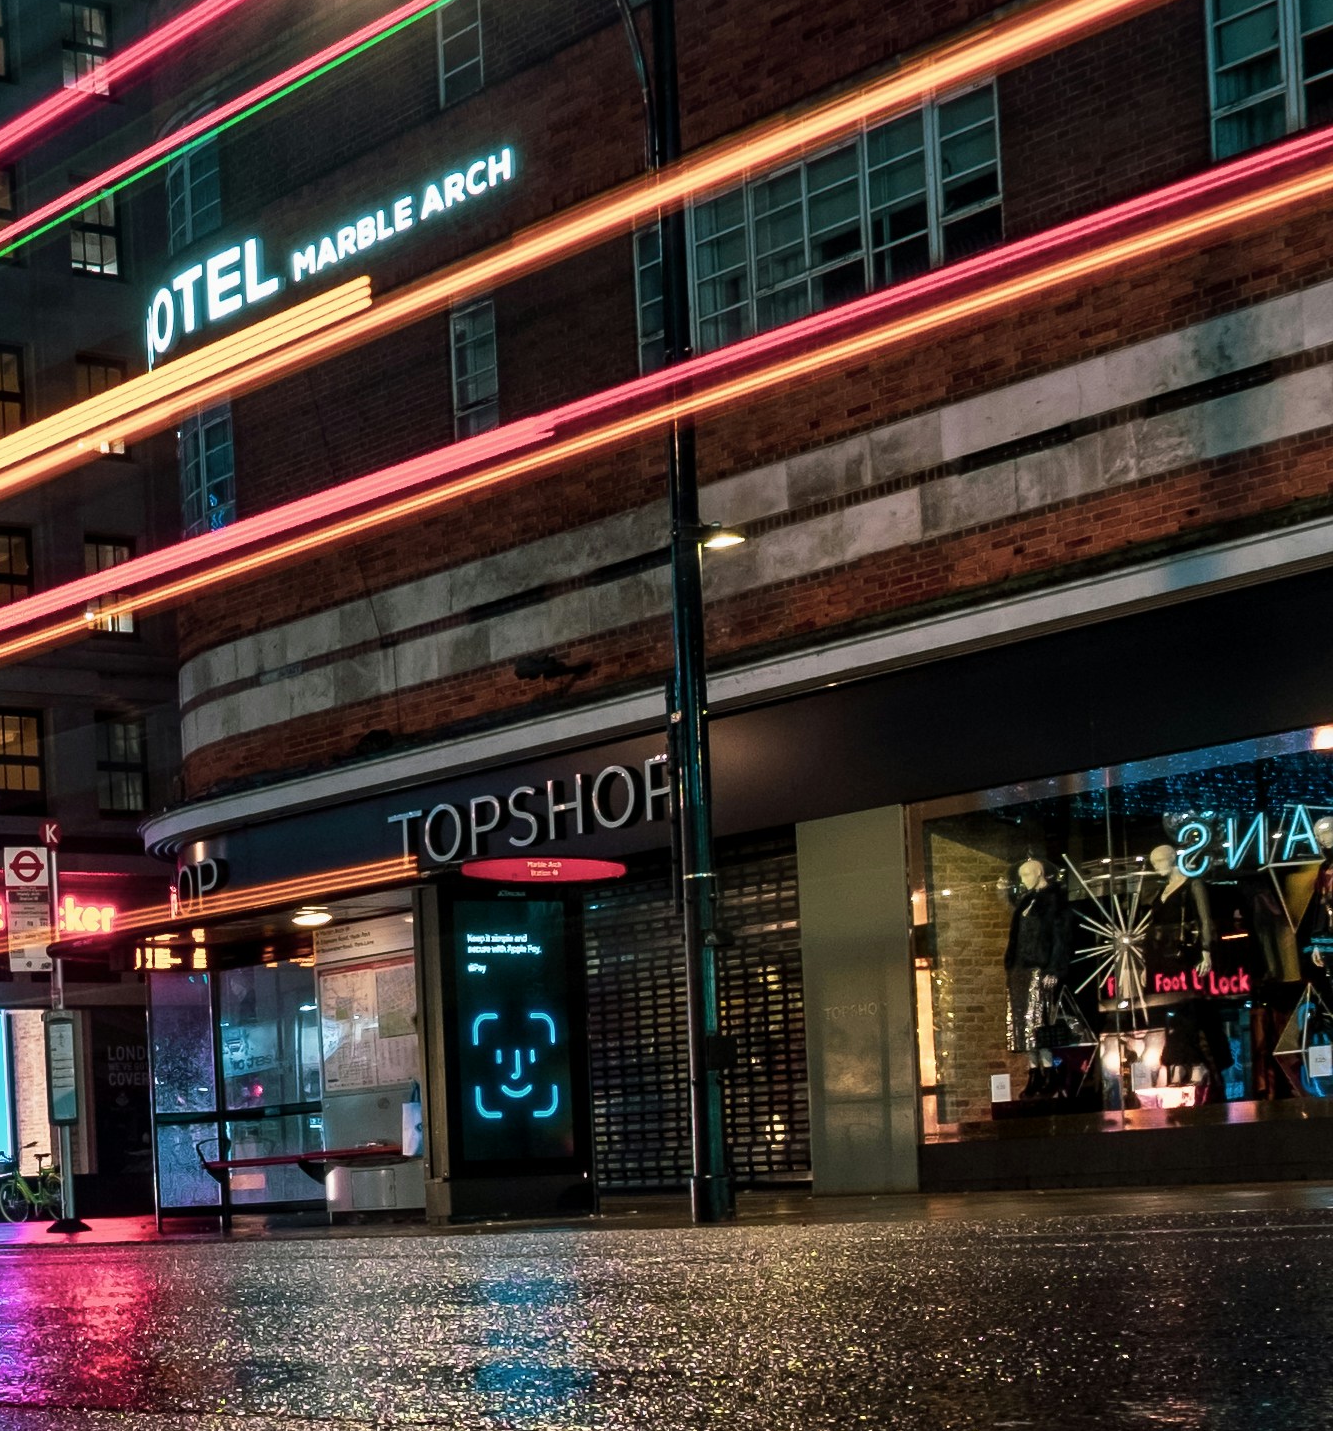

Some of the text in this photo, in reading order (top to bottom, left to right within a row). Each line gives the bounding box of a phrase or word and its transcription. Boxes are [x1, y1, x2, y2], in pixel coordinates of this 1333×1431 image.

[293, 196, 413, 282] MARBLE
[420, 148, 512, 219] ARCH
[45, 824, 58, 843] K
[1155, 971, 1187, 993] Foot
